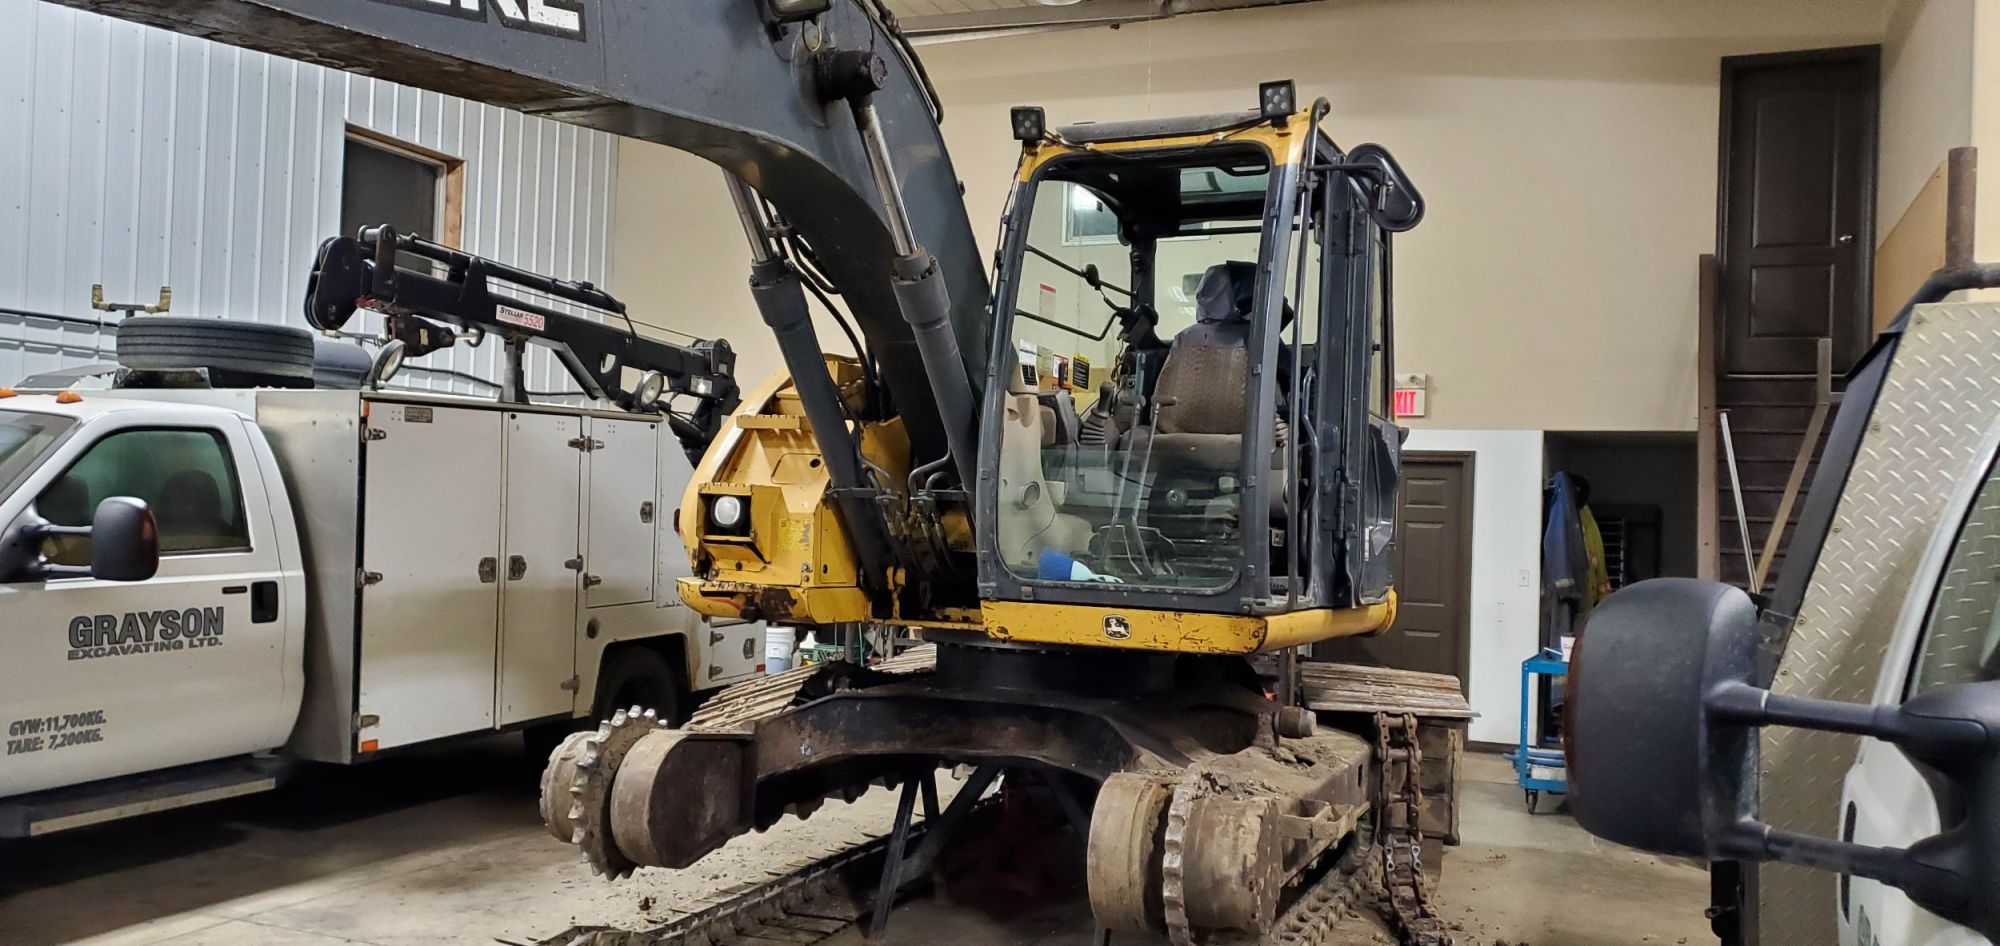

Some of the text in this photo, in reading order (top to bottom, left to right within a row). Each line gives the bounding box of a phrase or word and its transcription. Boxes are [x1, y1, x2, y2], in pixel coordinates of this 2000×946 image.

[523, 314, 544, 329] 5520
[1394, 391, 1416, 414] XIT
[68, 606, 224, 648] GRAYSON
[67, 636, 223, 661] EXCAVATING LTD.
[7, 728, 104, 755] TARE: 7,200KG.
